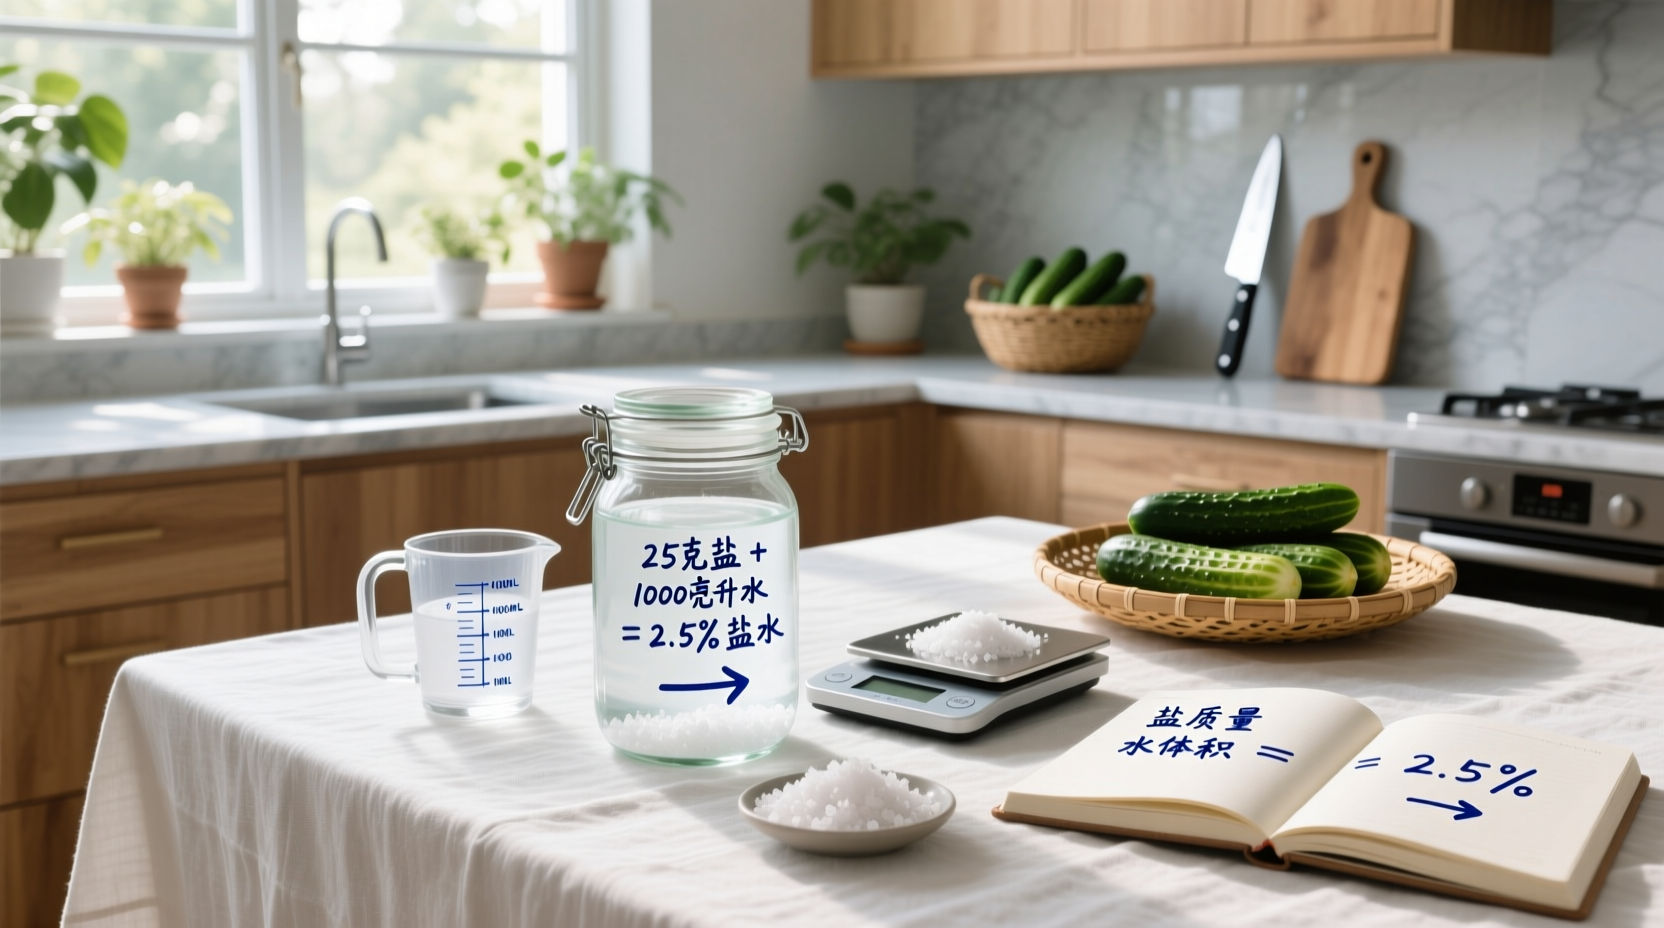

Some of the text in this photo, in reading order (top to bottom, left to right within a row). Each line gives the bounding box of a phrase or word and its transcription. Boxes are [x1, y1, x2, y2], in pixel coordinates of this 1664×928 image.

[641, 535, 742, 571] 25克盐
[1146, 706, 1262, 731] 盐质量
[1118, 735, 1235, 760] 水体积
[1403, 754, 1538, 797] 2.5%
